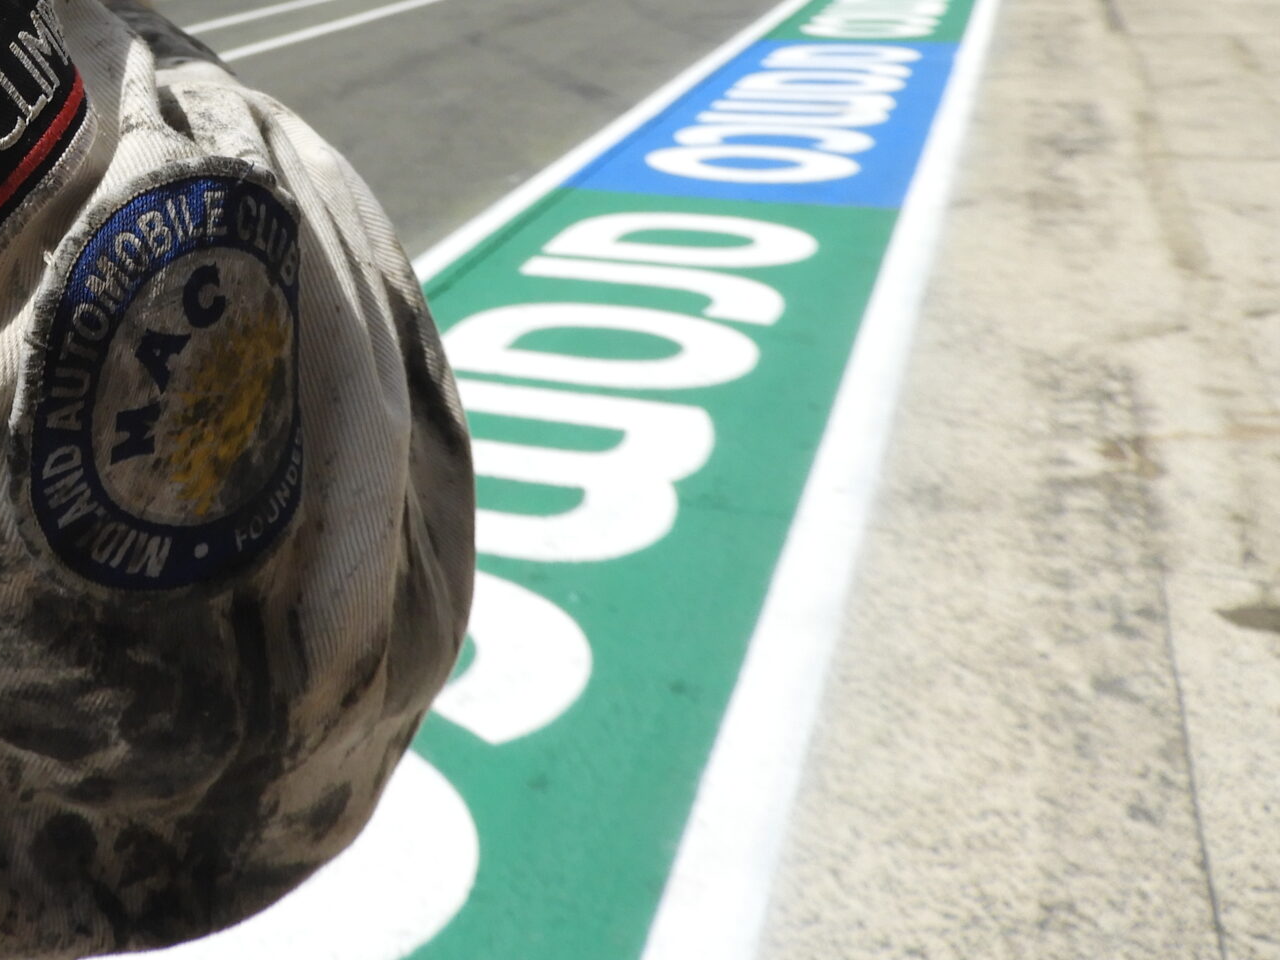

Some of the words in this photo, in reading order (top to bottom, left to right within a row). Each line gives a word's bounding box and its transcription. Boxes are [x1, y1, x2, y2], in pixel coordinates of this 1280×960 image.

[644, 43, 924, 184] aramco
[46, 191, 228, 432] AUTOMOBILE
[236, 195, 299, 287] CLUB
[120, 212, 819, 960] aram
